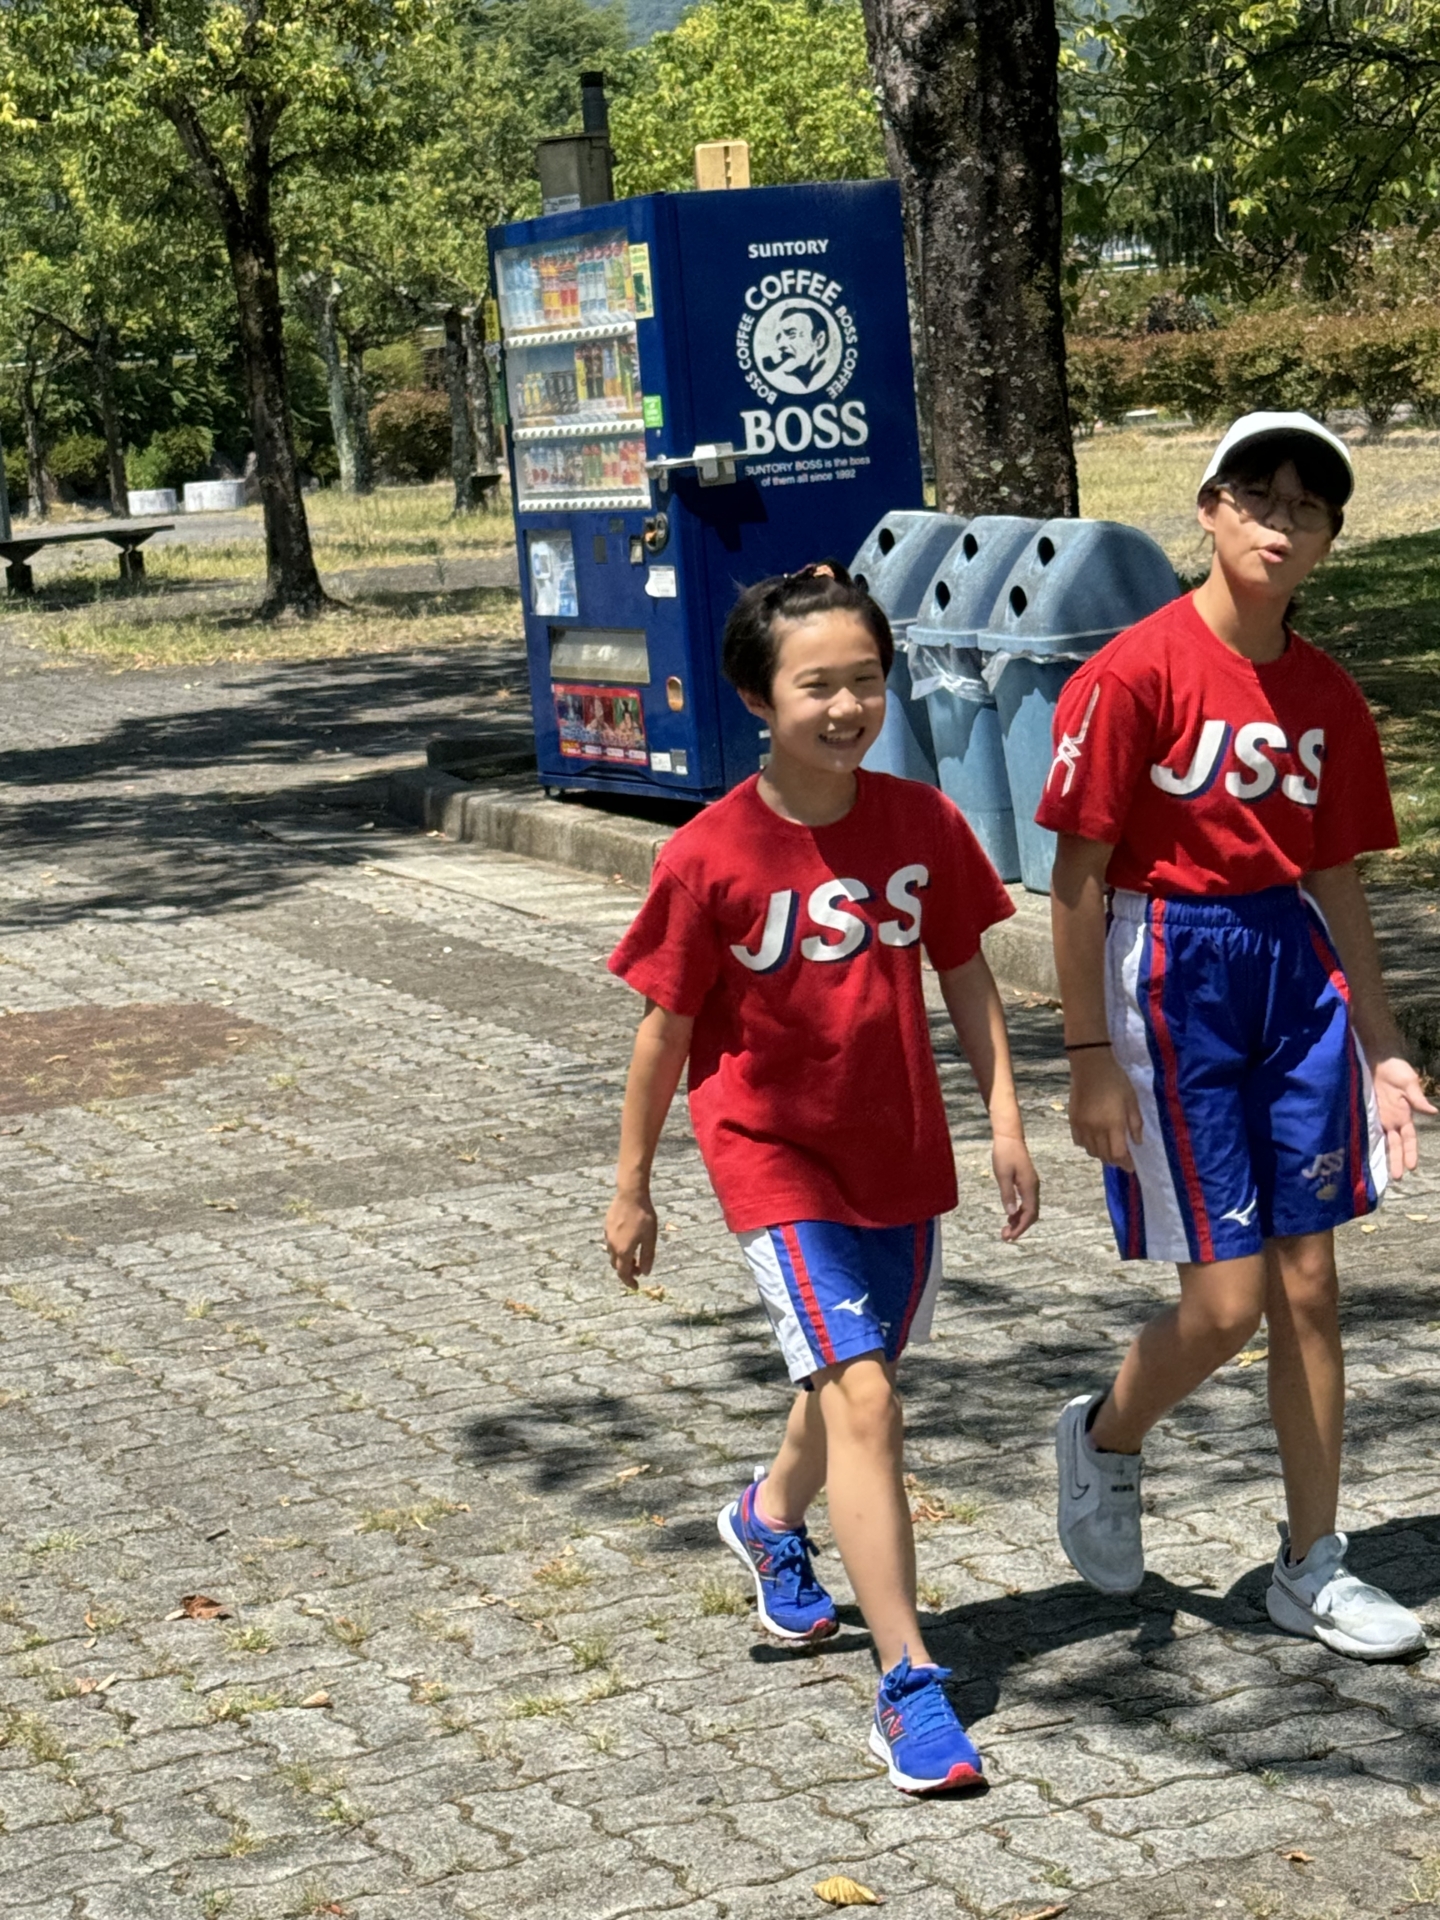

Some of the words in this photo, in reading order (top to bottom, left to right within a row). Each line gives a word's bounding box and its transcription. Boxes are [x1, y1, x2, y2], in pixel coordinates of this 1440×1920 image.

[748, 239, 829, 259] SUNTORY
[745, 269, 842, 311] COFFEE
[736, 313, 755, 370] COFFEE
[835, 305, 858, 344] BOSS
[744, 371, 778, 405] BOSS
[826, 348, 858, 400] COFFEE
[740, 401, 869, 455] BOSS
[744, 462, 793, 476] SUNTORY
[795, 459, 823, 471] BOSS
[833, 457, 848, 467] the
[1150, 719, 1328, 806] JSS
[729, 863, 931, 964] JSS
